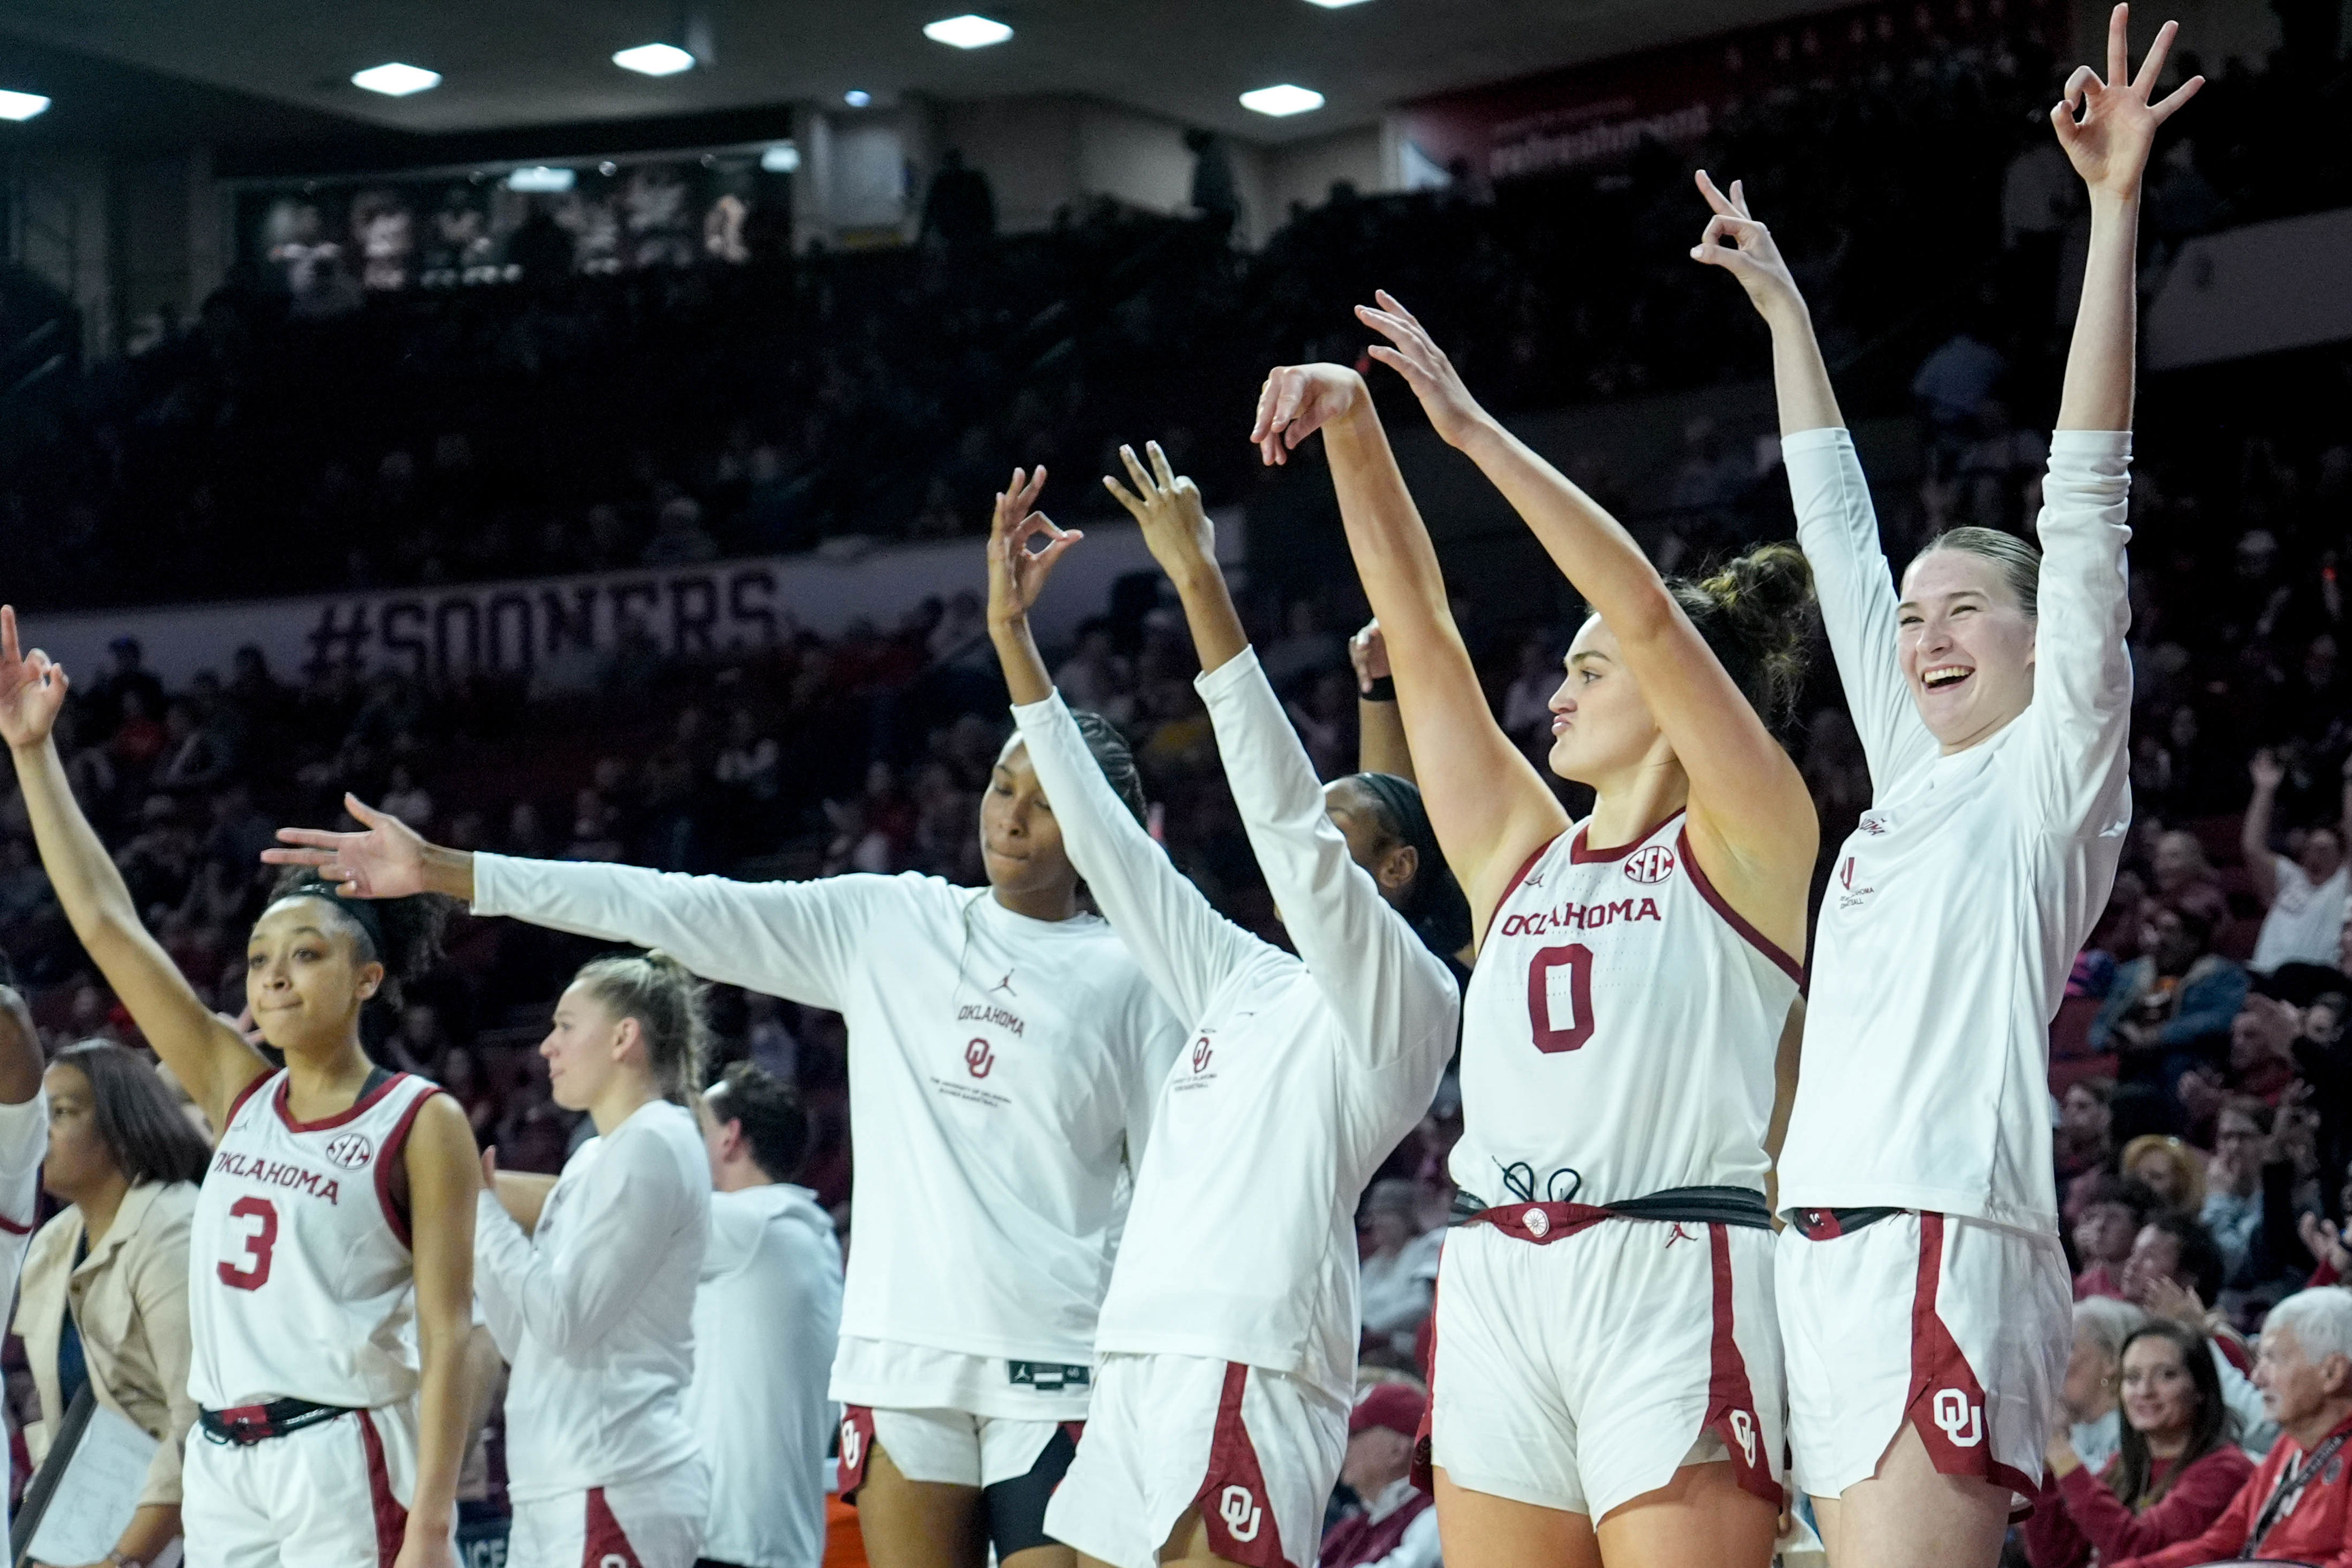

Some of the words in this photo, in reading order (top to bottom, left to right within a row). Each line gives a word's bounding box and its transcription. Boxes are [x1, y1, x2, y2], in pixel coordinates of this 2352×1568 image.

[1624, 846, 1674, 883] SEC
[1501, 898, 1661, 936] OKLAHOMA
[957, 1004, 1026, 1038] OKLAHOMA
[1528, 943, 1595, 1054] 0
[965, 1037, 995, 1078] OU
[1193, 1037, 1213, 1074] OU
[327, 1134, 372, 1170] SEC
[216, 1196, 278, 1292] 3
[1729, 1409, 1756, 1469] OU
[1933, 1388, 1982, 1447] OU
[842, 1419, 862, 1470] OU
[1219, 1485, 1262, 1542] OU
